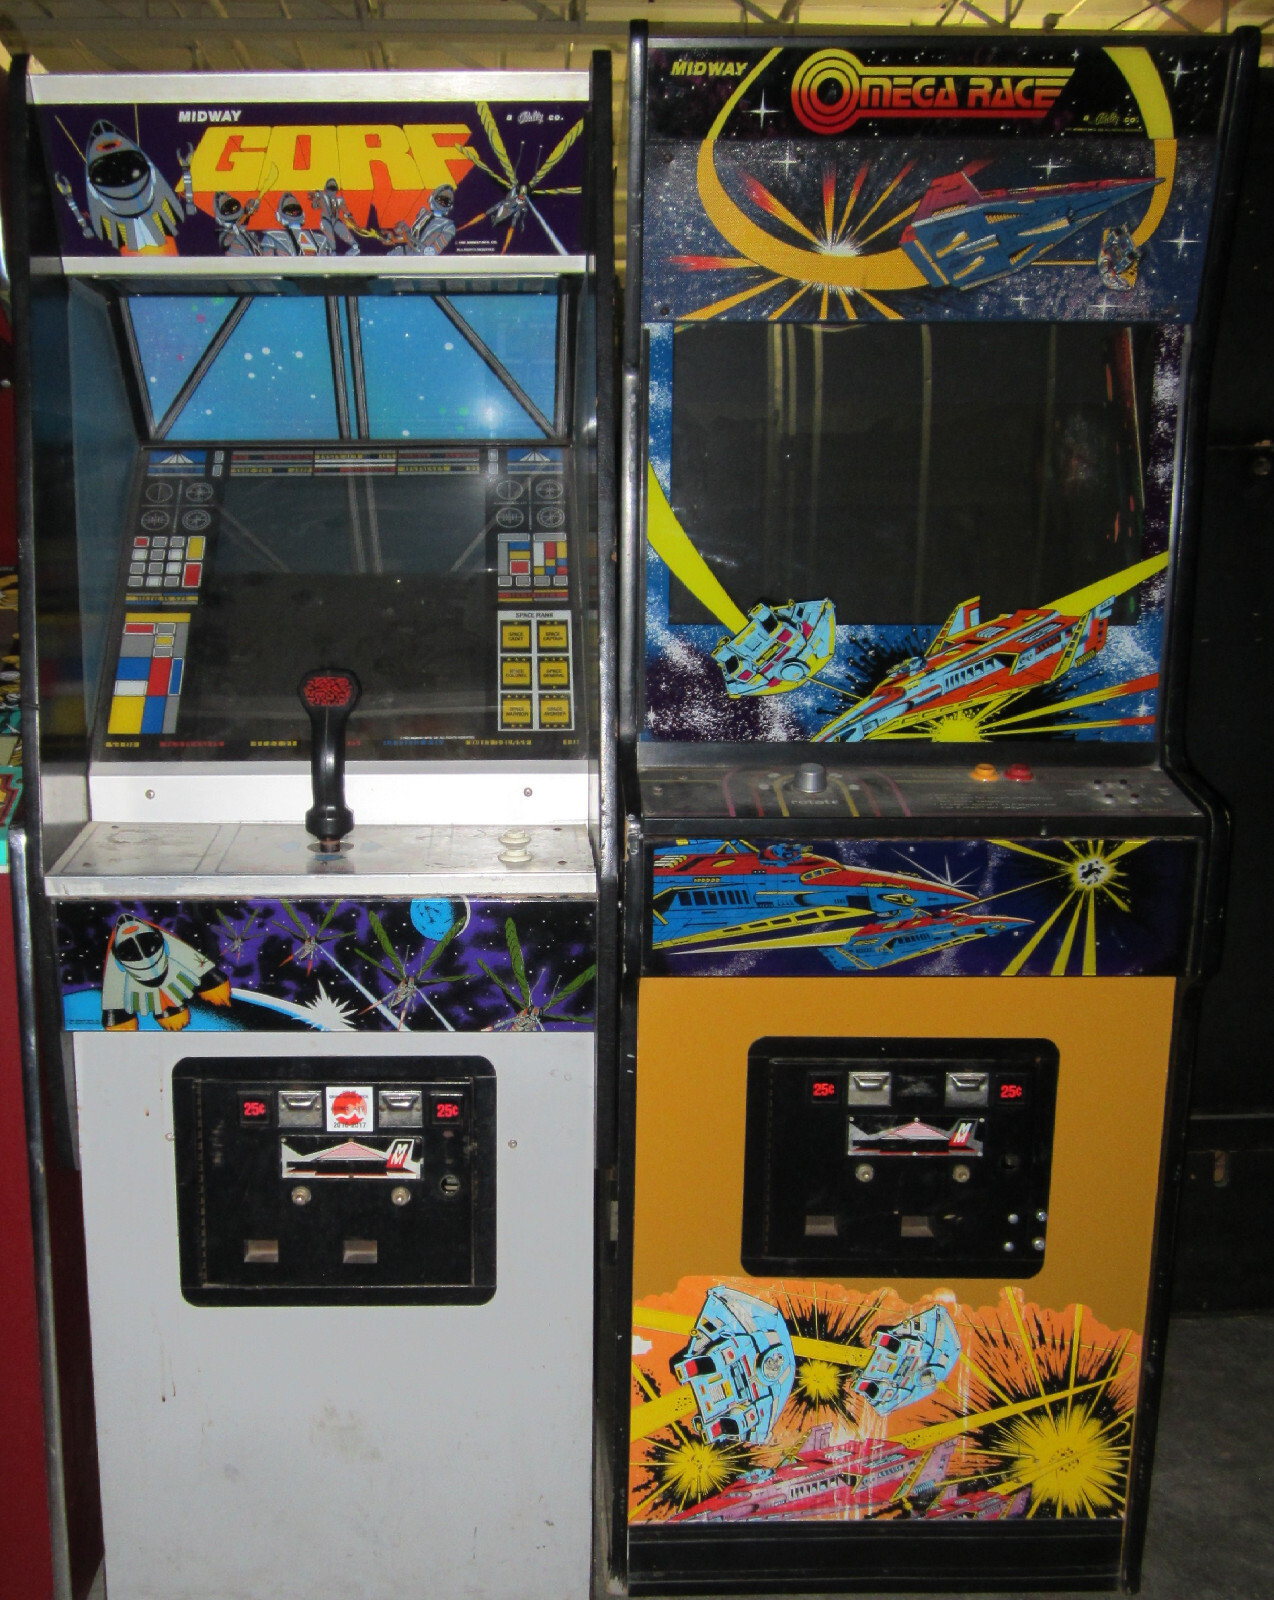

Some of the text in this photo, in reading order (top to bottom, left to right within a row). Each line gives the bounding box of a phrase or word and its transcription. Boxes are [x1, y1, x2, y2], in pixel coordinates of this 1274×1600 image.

[671, 61, 749, 76] MIDWAY
[791, 48, 1070, 135] OMEGA RACE
[178, 110, 242, 122] MIDWAY
[175, 124, 479, 200] GORF
[813, 1082, 835, 1097] 25¢
[1000, 1084, 1023, 1099] 25¢
[244, 1102, 266, 1117] 25¢
[436, 1103, 460, 1118] 25¢
